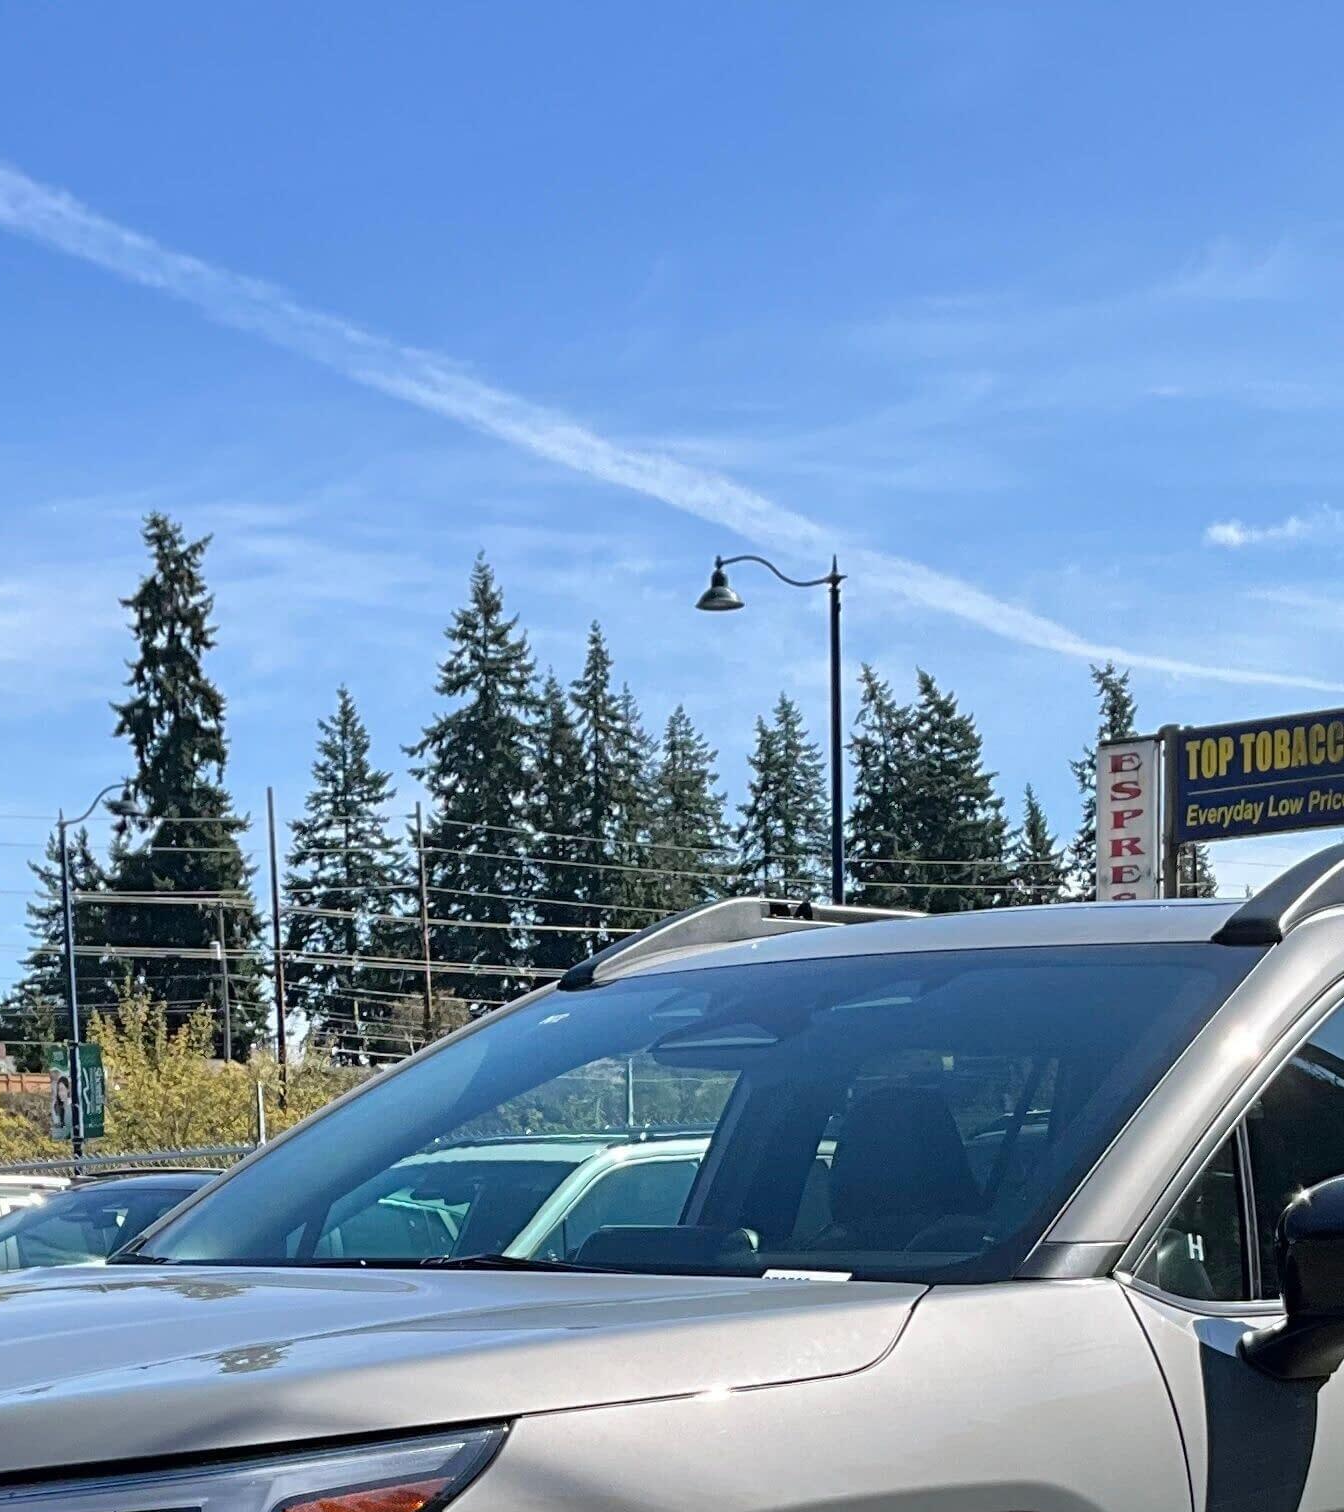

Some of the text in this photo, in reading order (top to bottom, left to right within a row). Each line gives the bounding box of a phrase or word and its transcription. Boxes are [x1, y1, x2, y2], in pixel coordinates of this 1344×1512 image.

[1186, 736, 1234, 780] TOP
[1108, 752, 1145, 899] ESPRE
[1186, 801, 1263, 828] Everyday
[1268, 795, 1304, 817] Low
[1187, 1233, 1204, 1261] H
